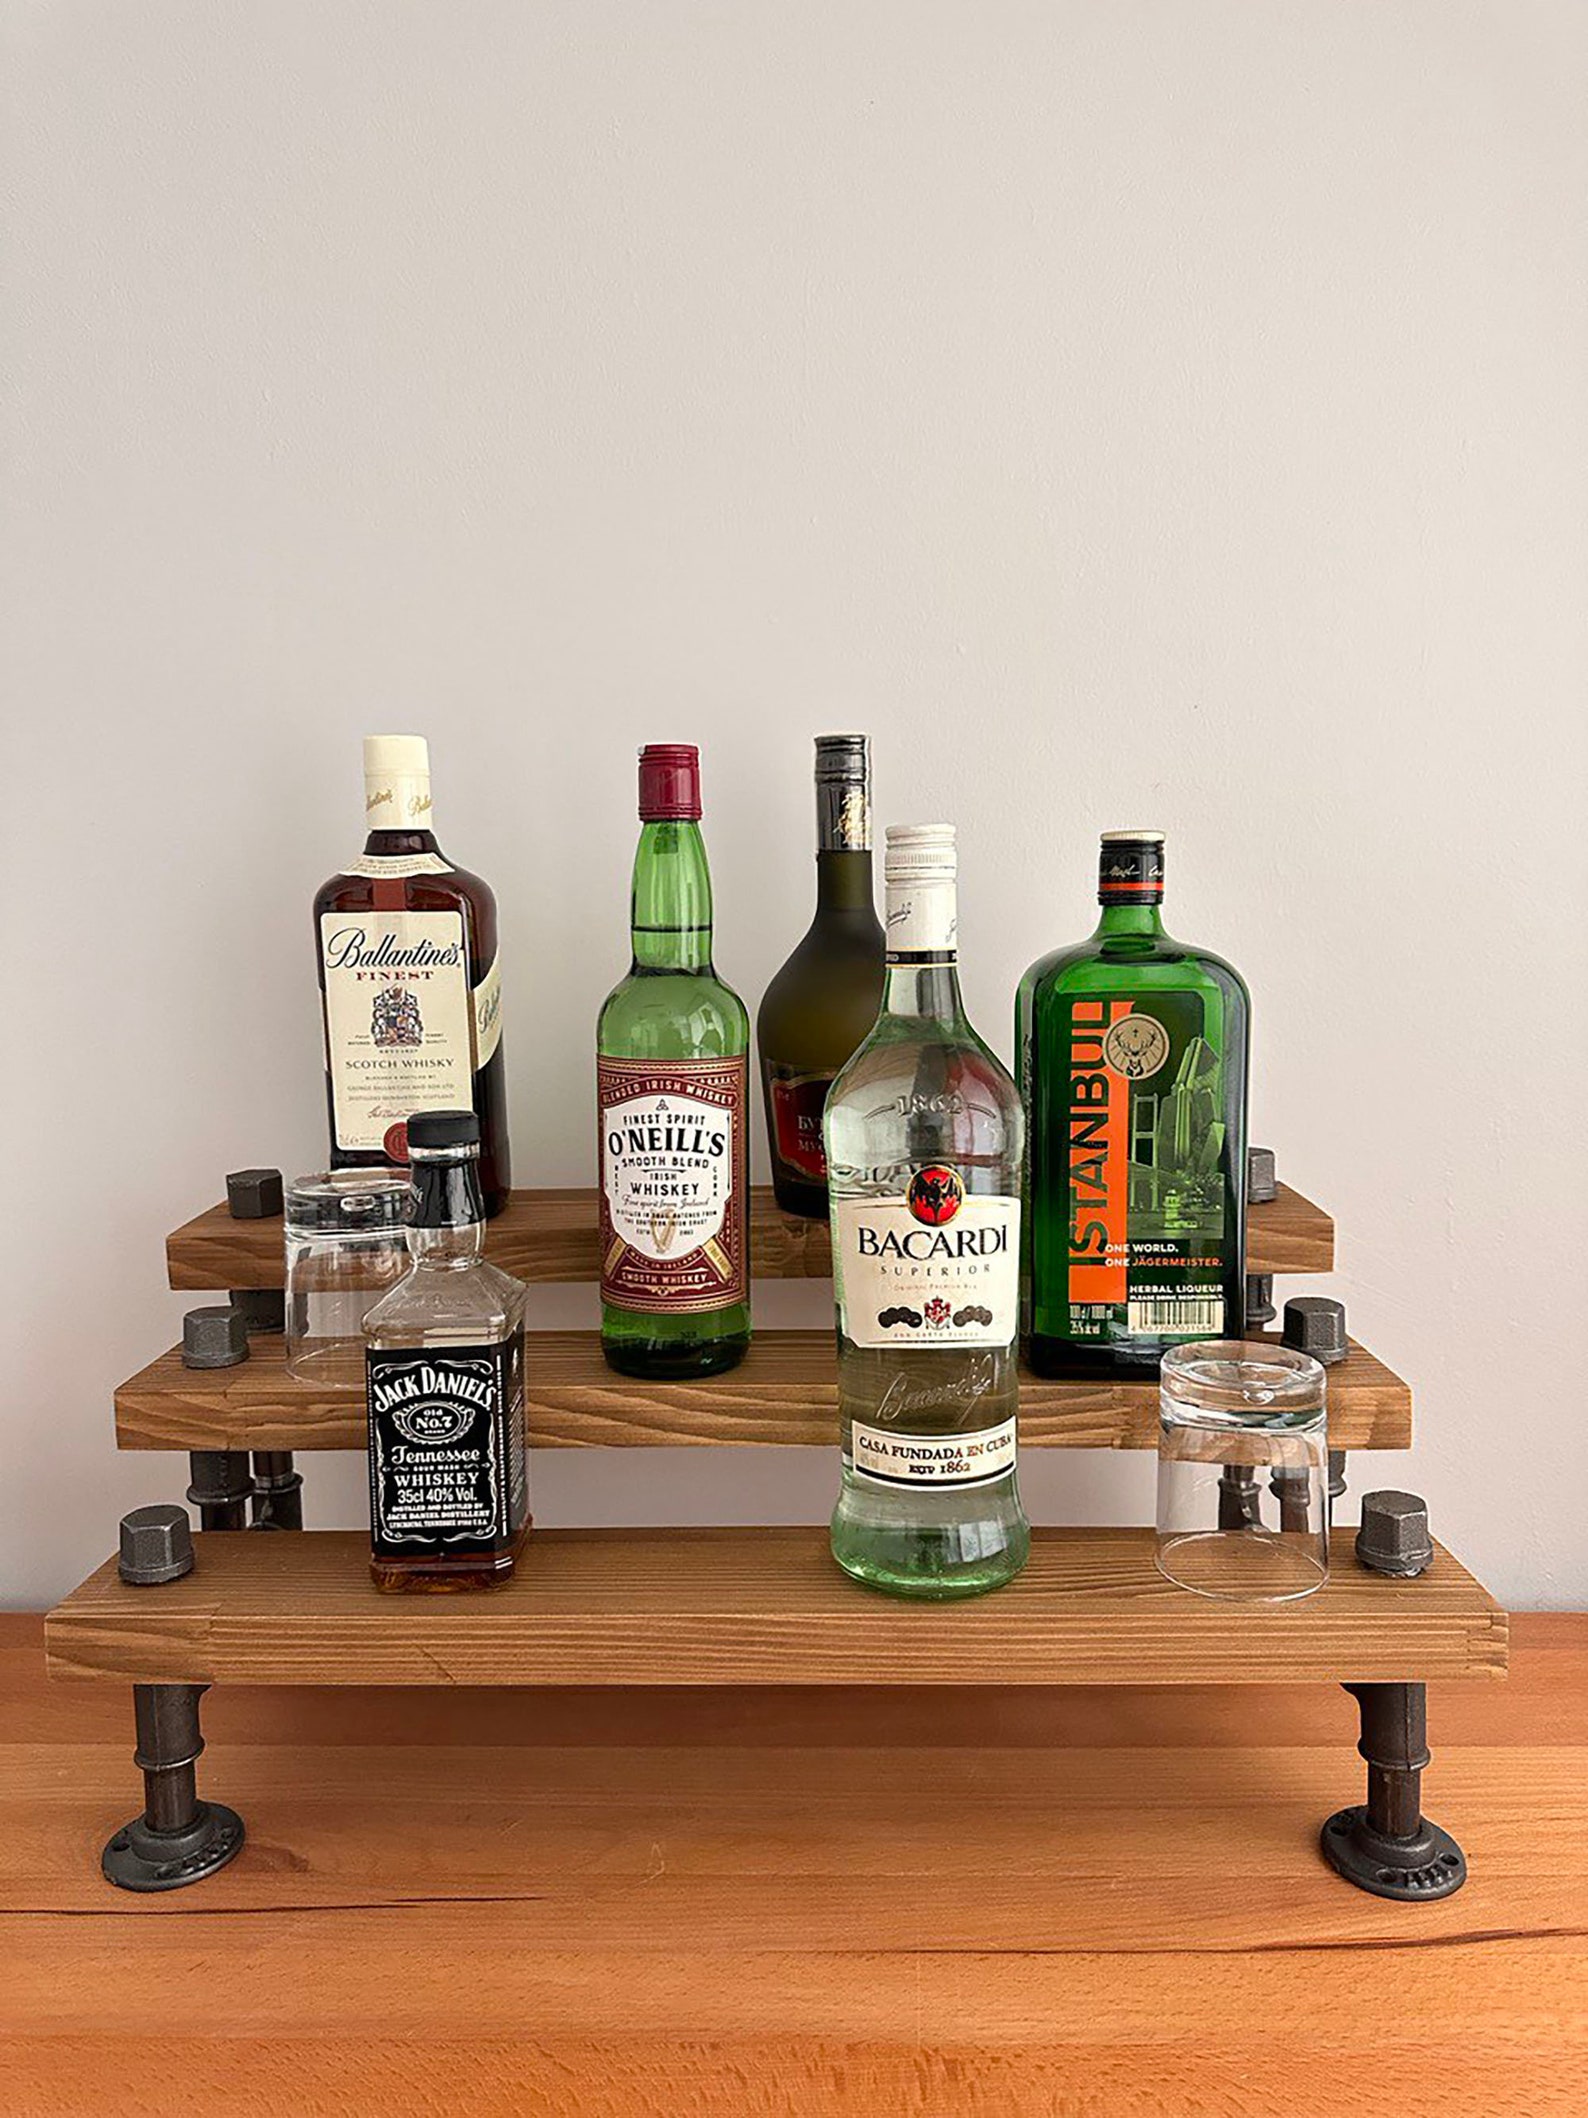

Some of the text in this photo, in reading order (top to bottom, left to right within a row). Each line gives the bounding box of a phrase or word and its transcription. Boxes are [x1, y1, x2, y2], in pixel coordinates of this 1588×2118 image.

[356, 971, 434, 981] FINEST
[346, 1059, 453, 1069] SCOTCH WHISKY
[646, 1080, 681, 1090] IRISH
[686, 1085, 734, 1105] WHISKEY
[623, 1114, 705, 1125] FINEST SPIRIT
[1069, 1001, 1111, 1266] ISTANBUL
[609, 1128, 725, 1157] O'NEILL'S
[622, 1157, 709, 1169] SMOOTH BLEND
[630, 1183, 699, 1196] WHISKEY
[858, 1225, 1007, 1260] BACARDI
[1105, 1244, 1179, 1253] ONE WORLD.
[1105, 1255, 1223, 1267] ONE JÄGERMEISTER.
[880, 1263, 990, 1276] SUPERIOR
[1130, 1285, 1223, 1293] HERBAL LIQUEUR
[373, 1375, 421, 1412] JACK
[859, 1433, 1012, 1460] CASA FUNDADA EN CUBA
[391, 1445, 480, 1464] Tennessee
[940, 1461, 971, 1474] 1862
[394, 1472, 479, 1487] WHISKEY
[397, 1487, 477, 1503] 35cl 40% Vol.
